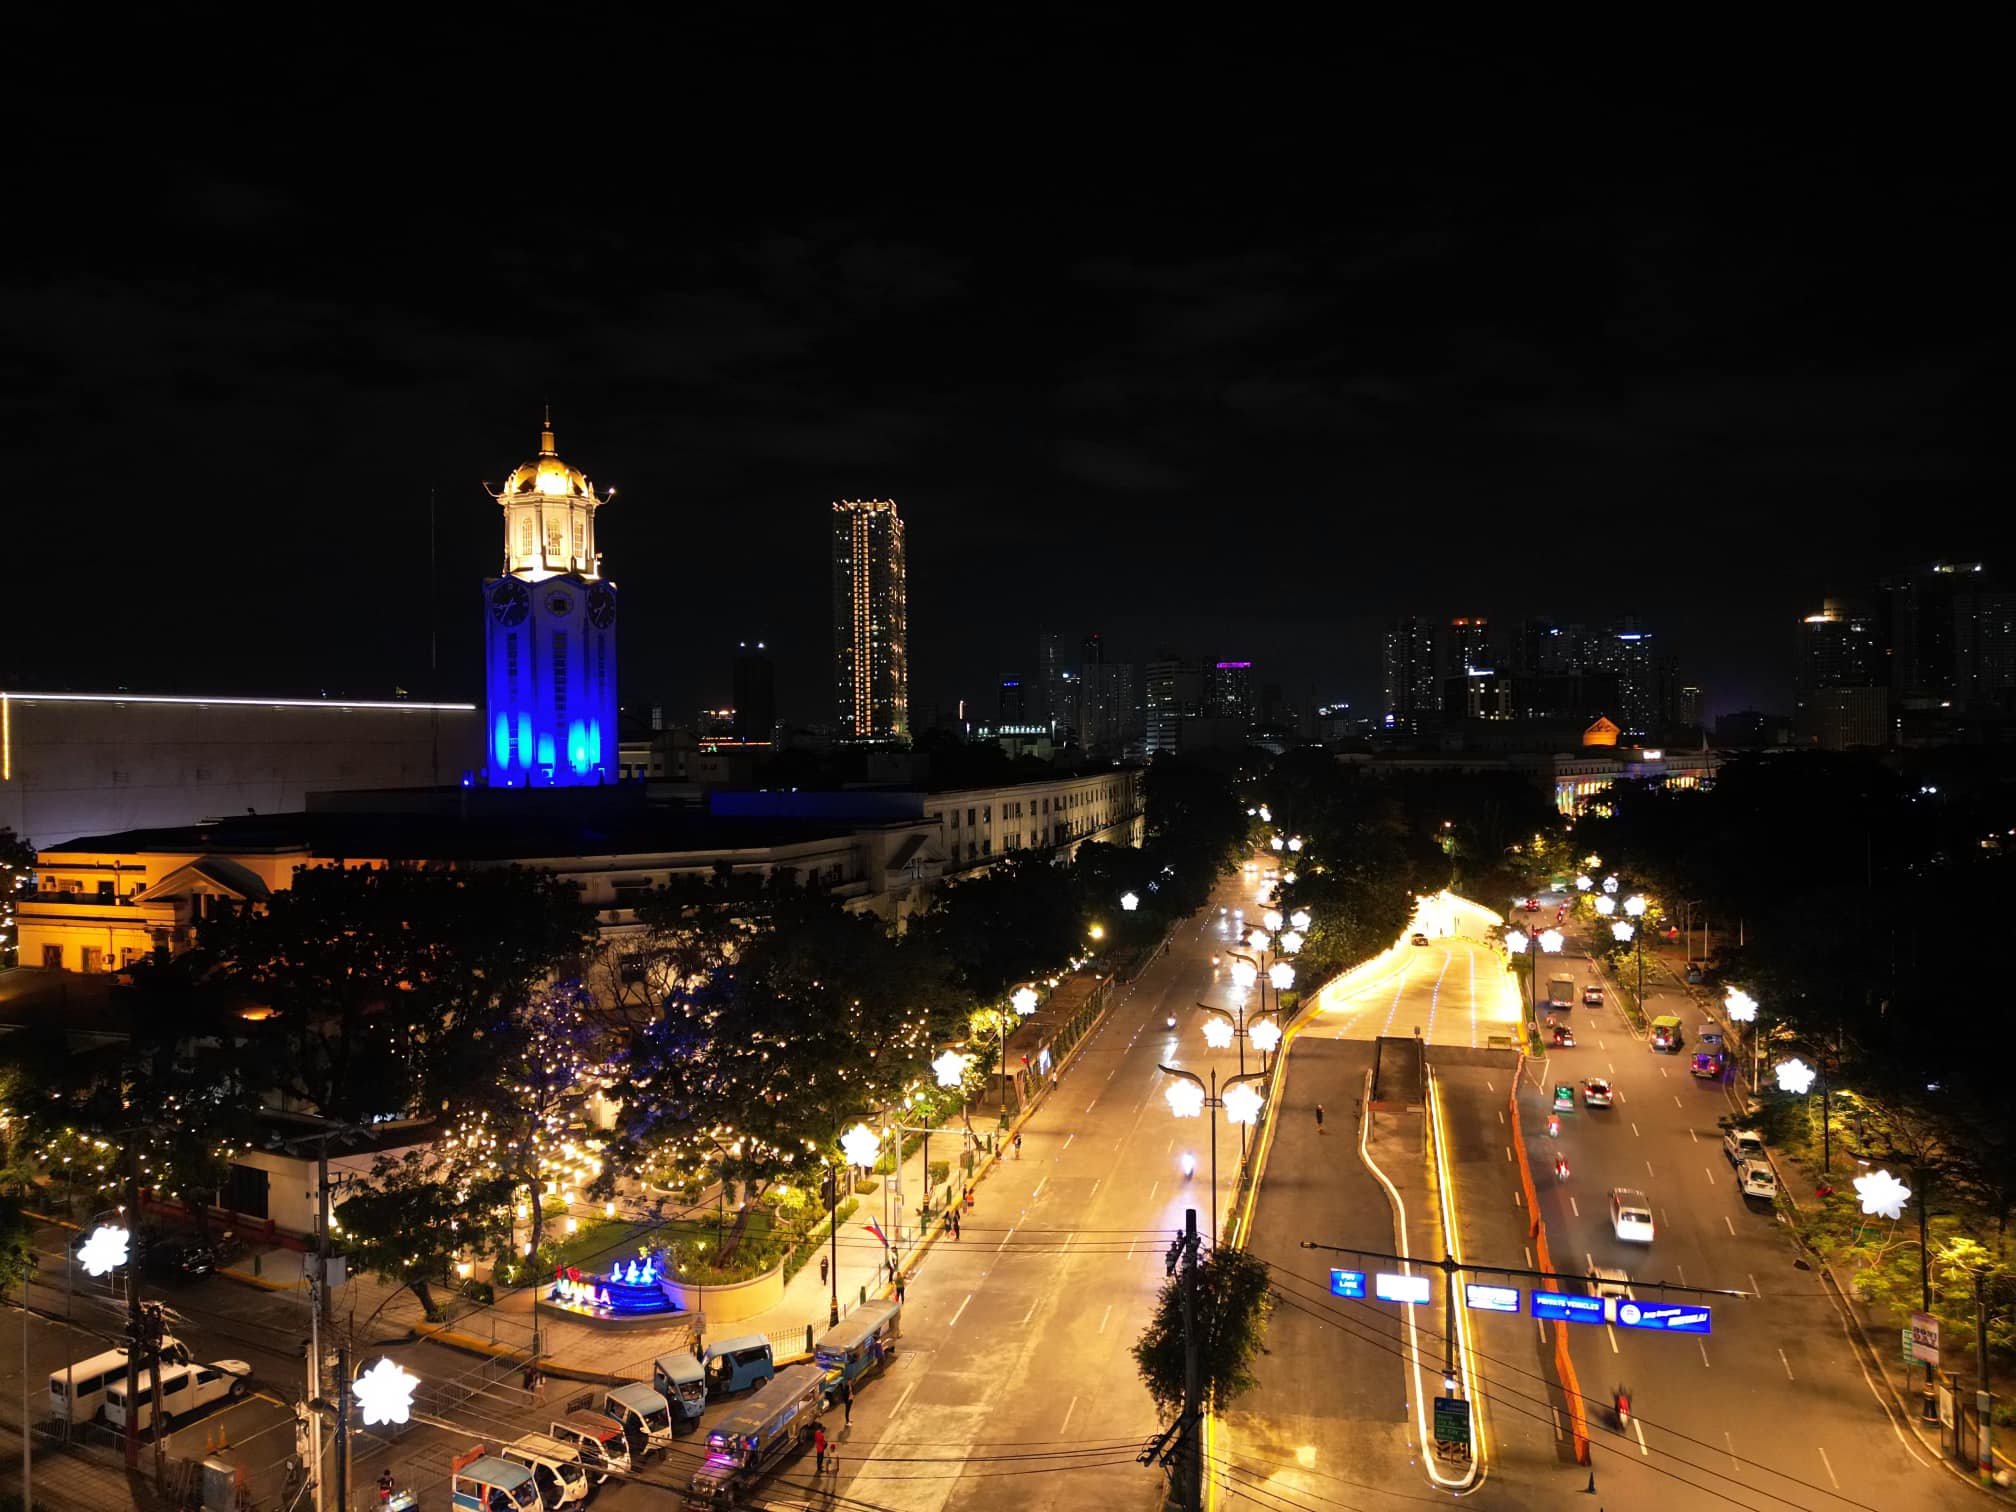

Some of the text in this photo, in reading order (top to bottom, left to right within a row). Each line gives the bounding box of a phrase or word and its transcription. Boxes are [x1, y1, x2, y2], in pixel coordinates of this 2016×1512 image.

[556, 1279, 611, 1305] MANILA
[1536, 1297, 1600, 1311] PRIVATE VEHICLES
